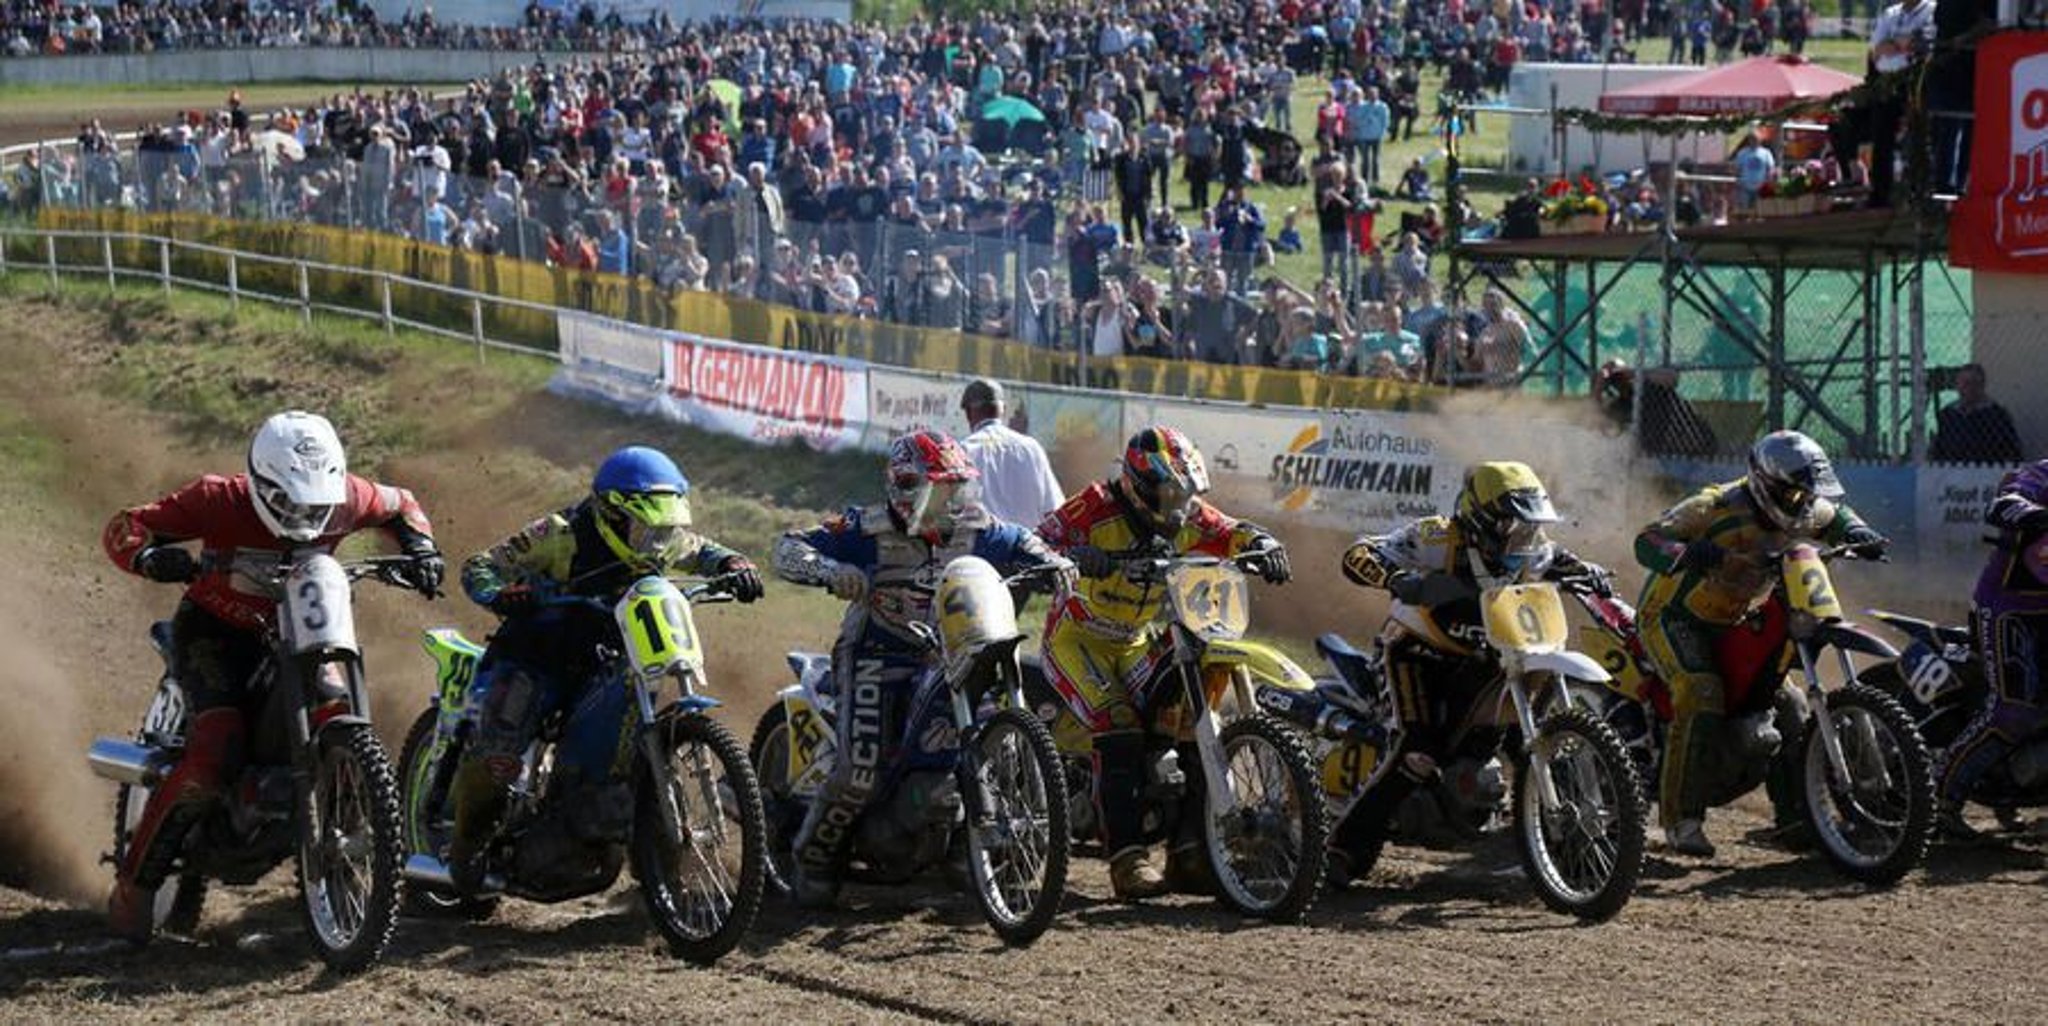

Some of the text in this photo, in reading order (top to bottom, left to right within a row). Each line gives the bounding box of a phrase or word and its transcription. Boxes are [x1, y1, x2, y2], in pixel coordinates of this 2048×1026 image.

[694, 344, 804, 420] GERMAN
[1332, 424, 1434, 455] Autohaus
[1267, 453, 1433, 496] SCHLINGMANN
[298, 580, 329, 631] 3
[1185, 579, 1231, 621] 41
[1801, 567, 1835, 608] 2
[633, 598, 693, 656] 19
[1517, 603, 1544, 645] 9
[1909, 653, 1949, 704] 18
[1341, 744, 1361, 790] 9
